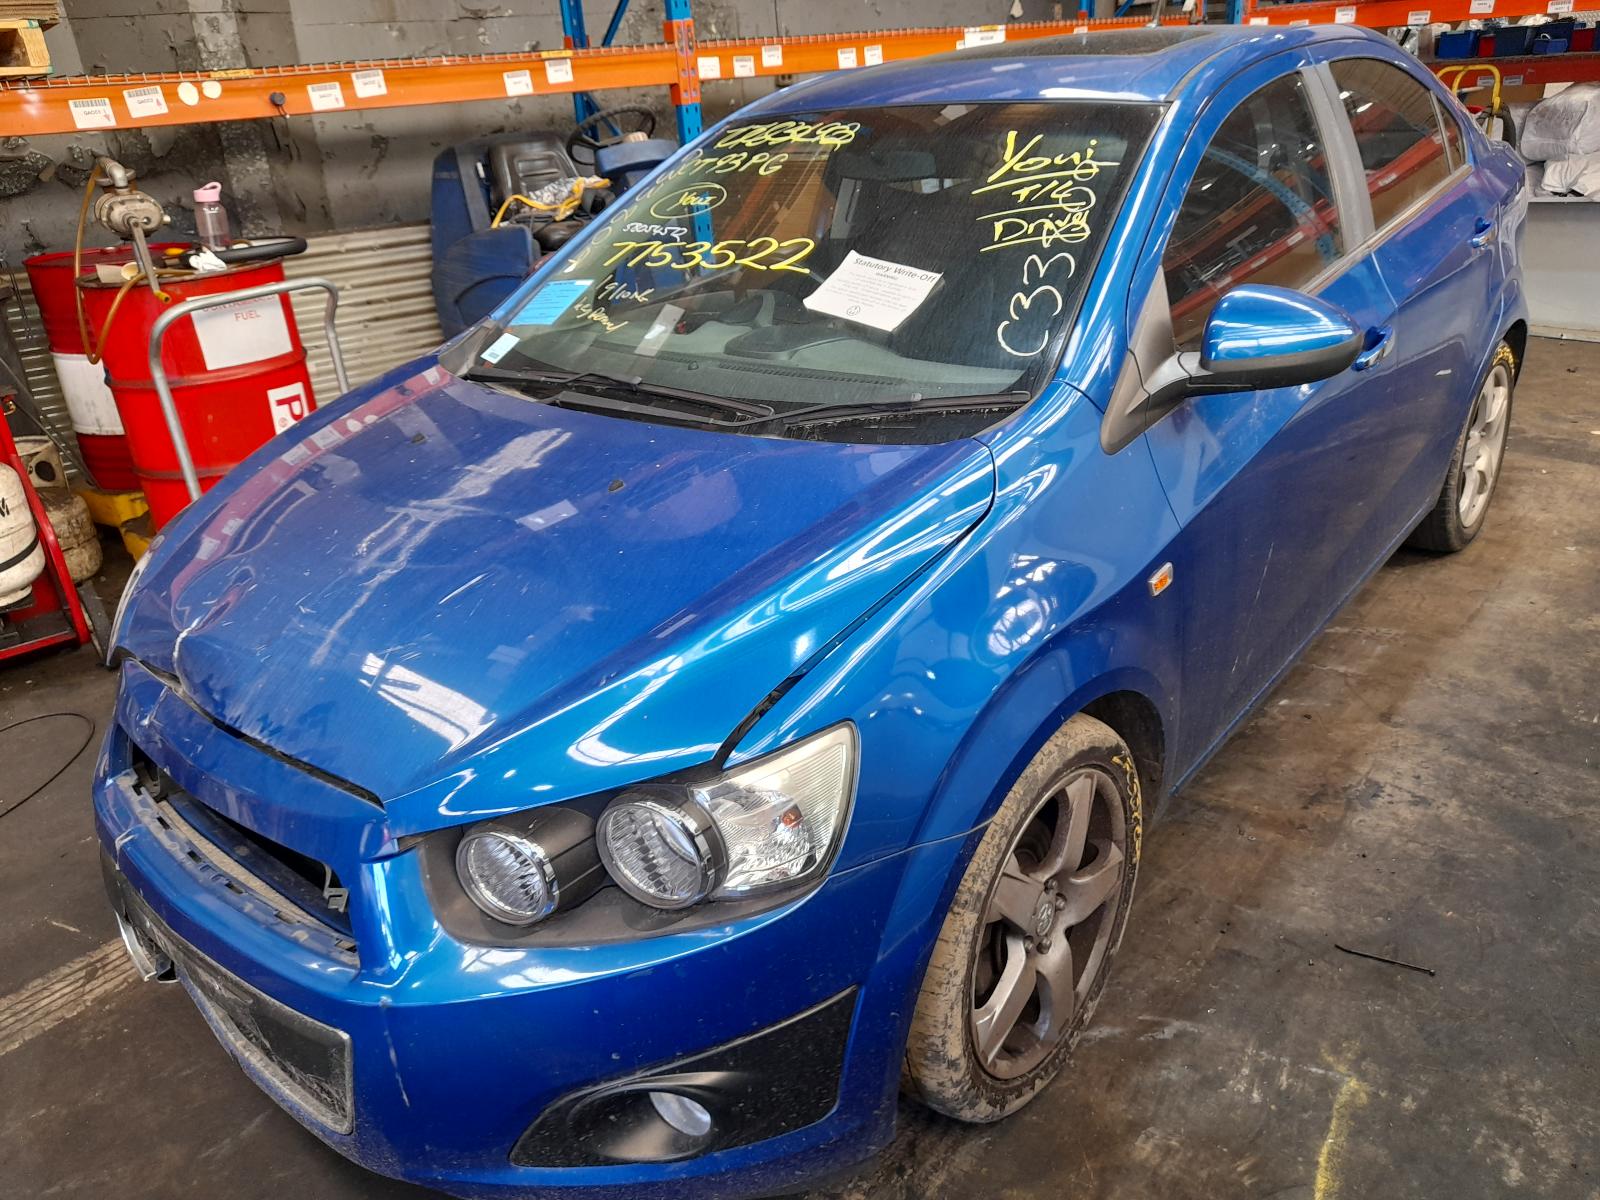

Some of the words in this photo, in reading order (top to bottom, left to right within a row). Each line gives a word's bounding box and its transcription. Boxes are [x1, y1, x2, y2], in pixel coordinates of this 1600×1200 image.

[854, 257, 893, 273] Statutory
[893, 267, 938, 284] Write-Off
[234, 309, 262, 321] FUEL
